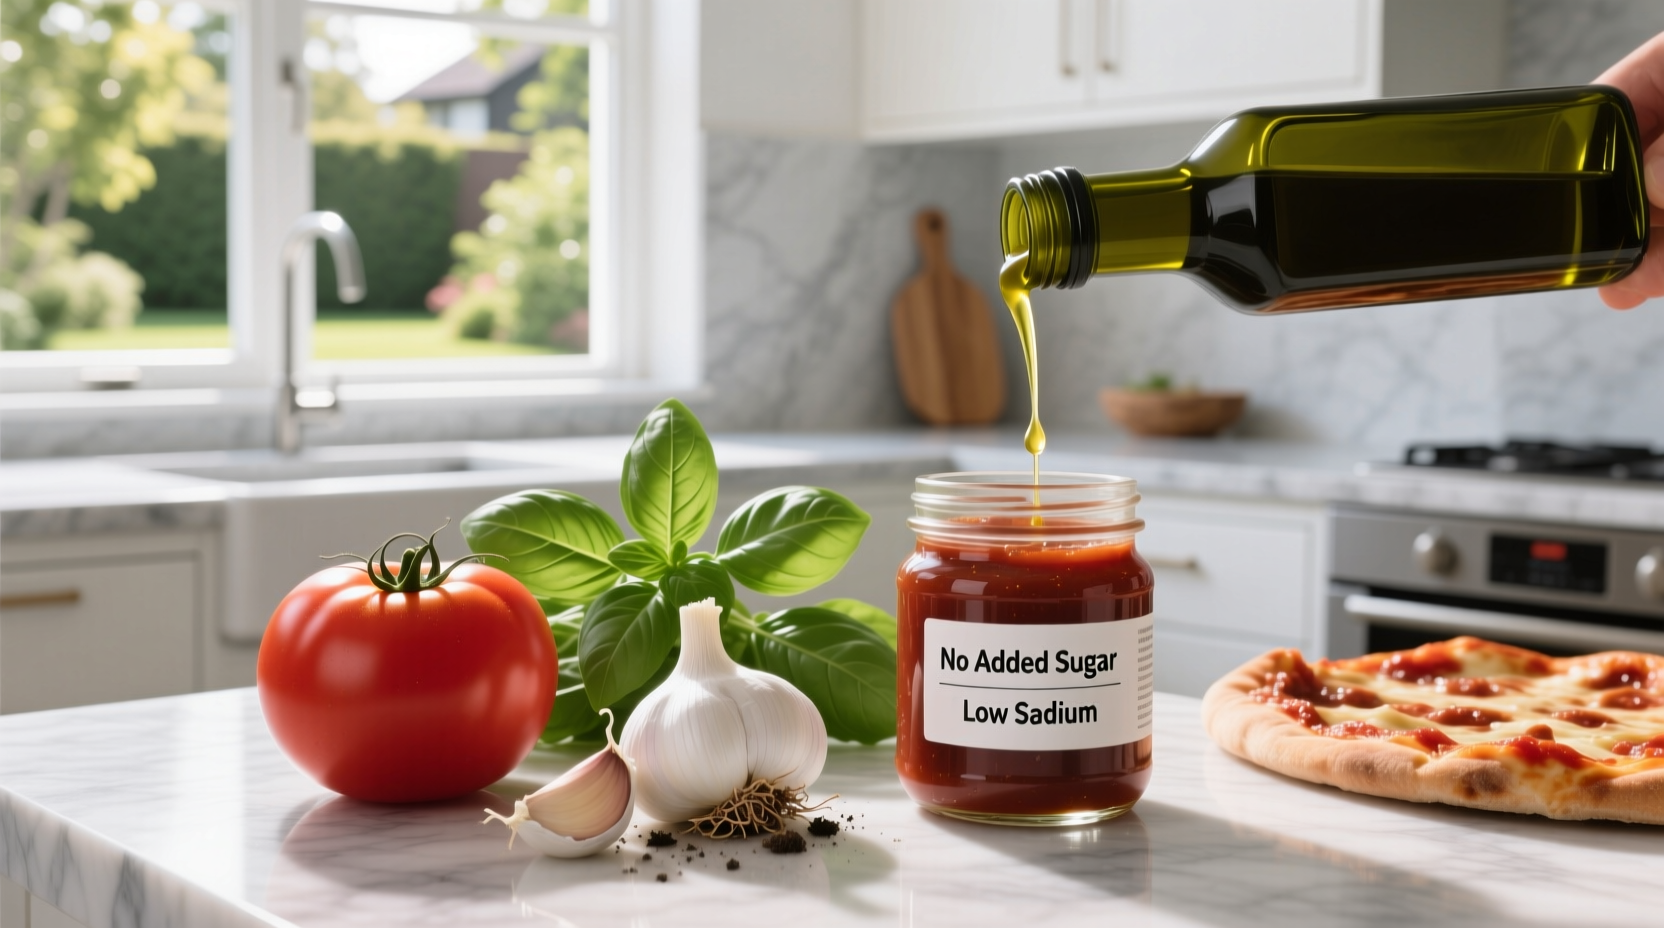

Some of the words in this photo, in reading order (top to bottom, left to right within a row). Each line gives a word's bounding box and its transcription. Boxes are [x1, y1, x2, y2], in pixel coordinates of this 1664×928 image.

[940, 647, 969, 671] No
[974, 649, 1049, 673] Added
[1055, 650, 1118, 679] Sugar
[963, 699, 1009, 724] Low
[1014, 701, 1098, 725] Sadium
